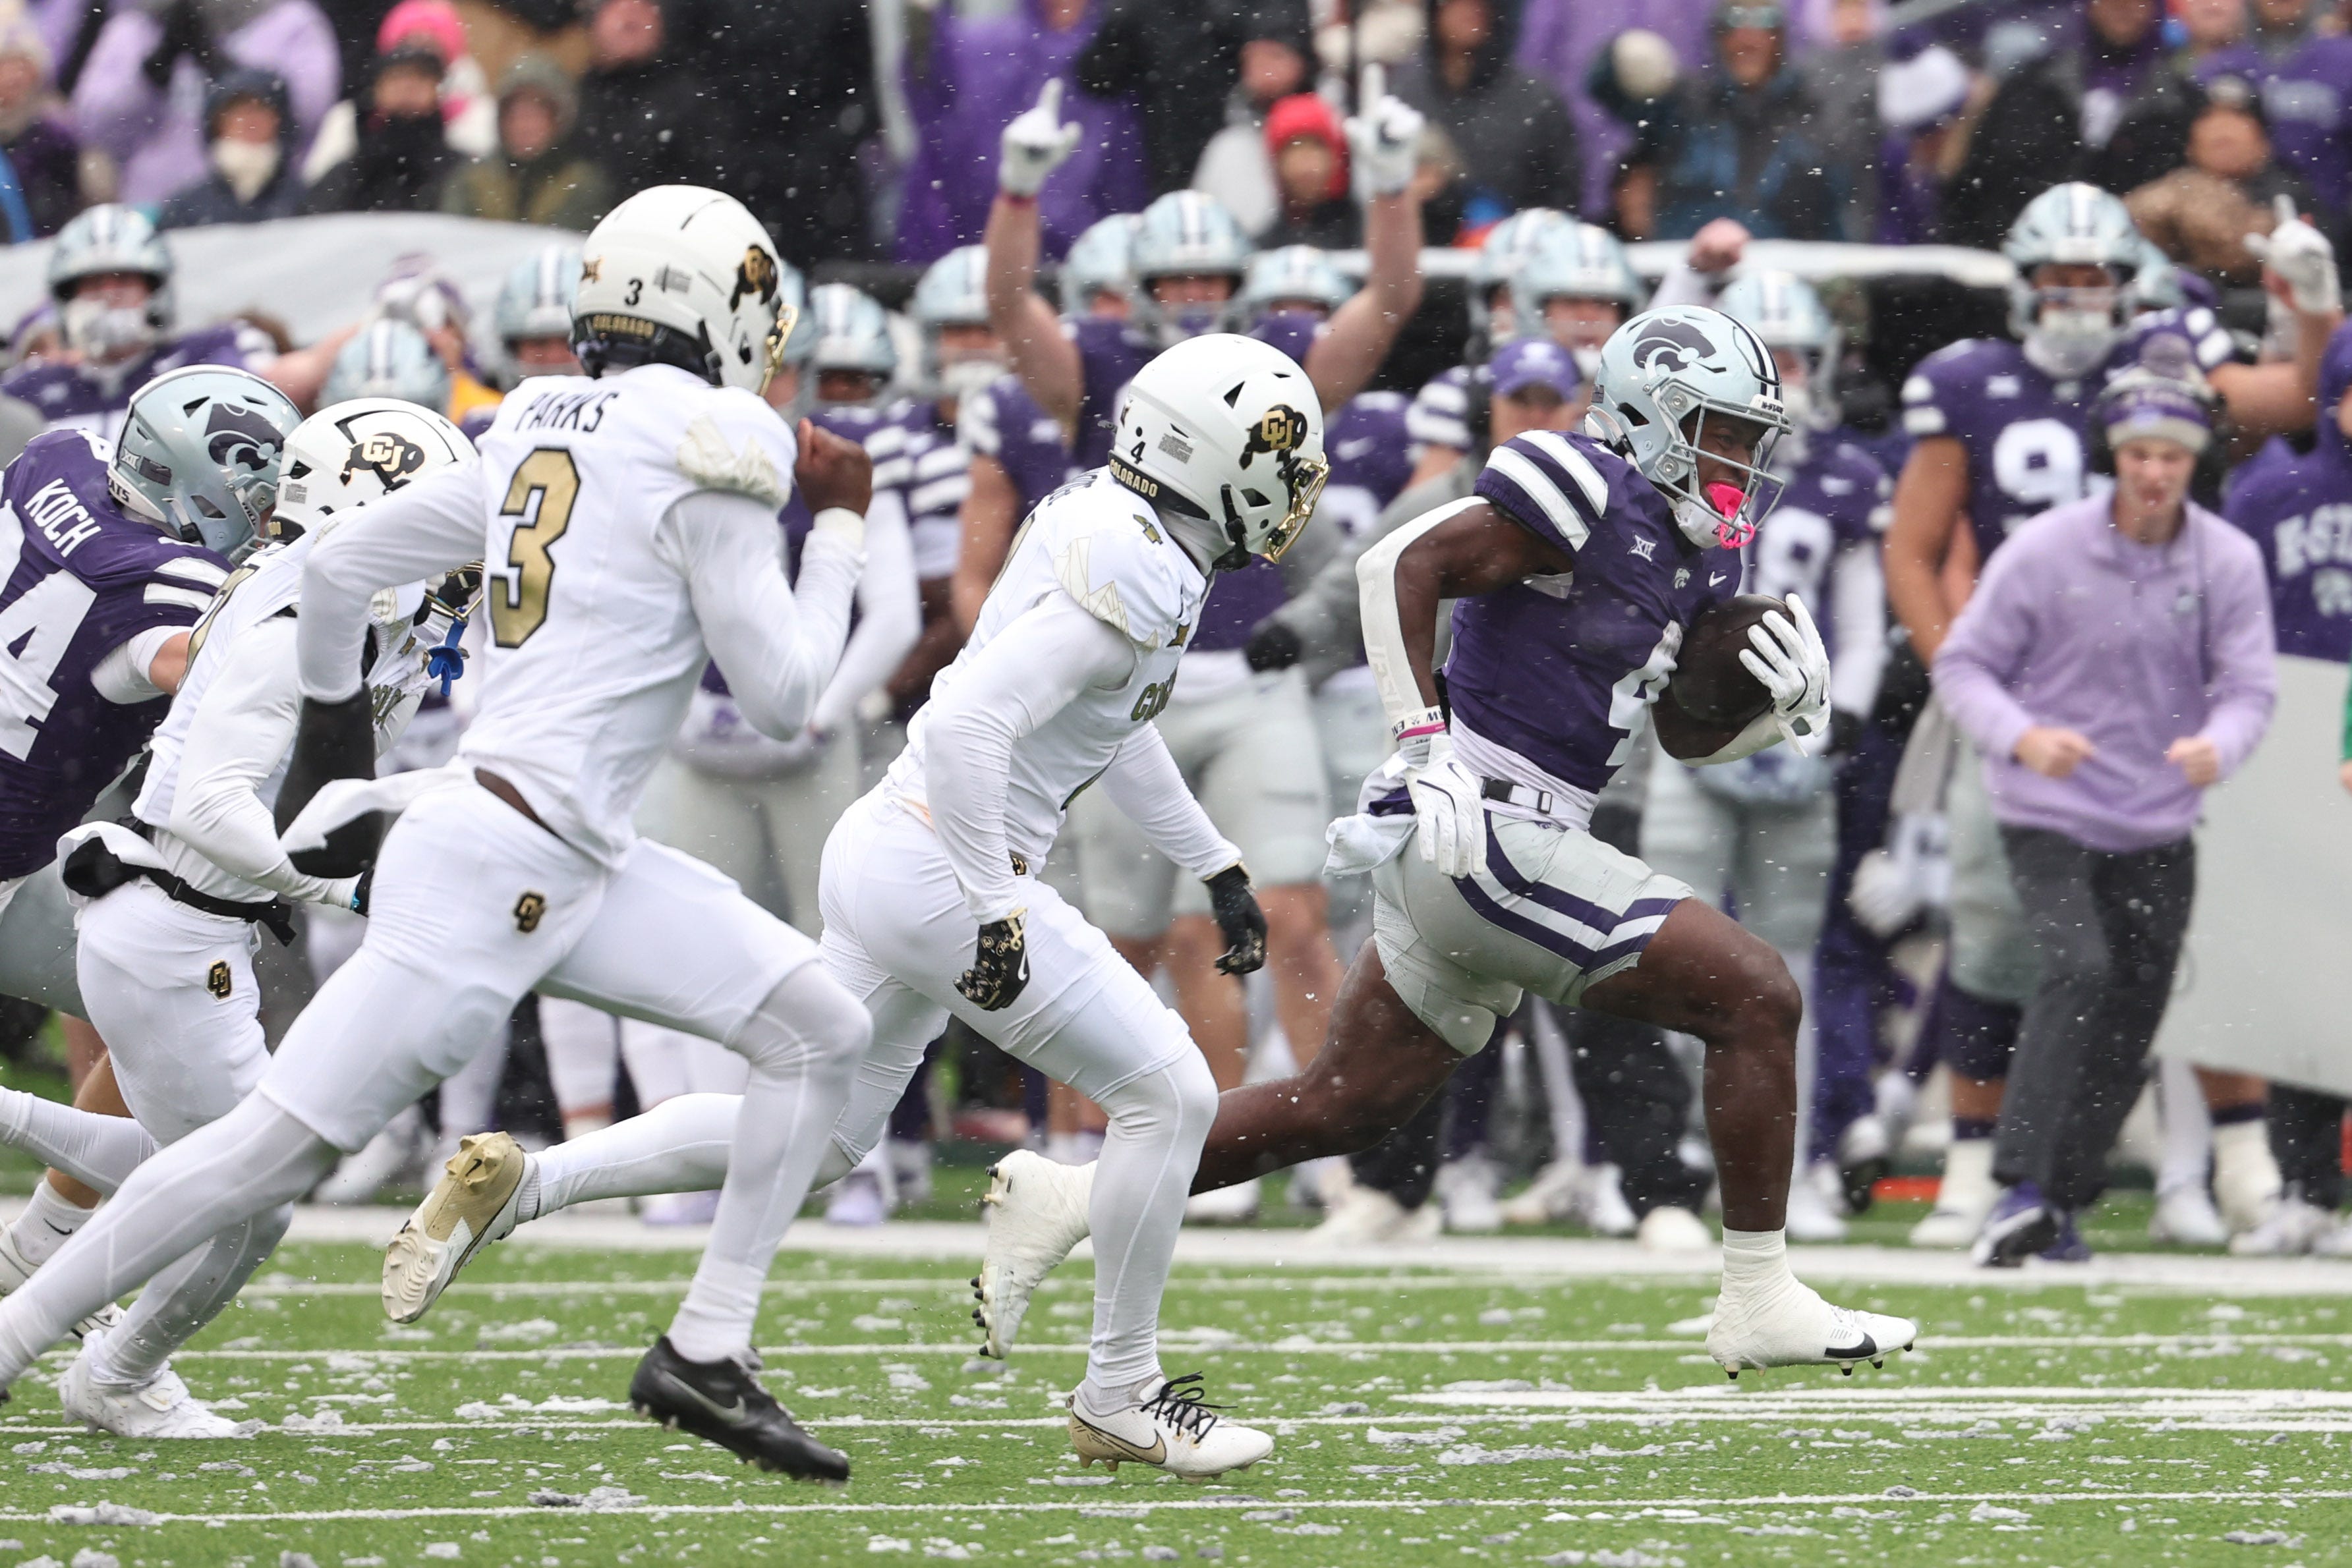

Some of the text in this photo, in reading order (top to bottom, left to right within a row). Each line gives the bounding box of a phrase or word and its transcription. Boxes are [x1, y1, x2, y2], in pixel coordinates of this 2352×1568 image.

[624, 278, 643, 306] 3
[514, 391, 619, 433] PARKS
[1131, 441, 1146, 464] 4
[1109, 458, 1159, 498] COLORADO
[23, 477, 102, 558] KOCH
[488, 445, 581, 649] 3
